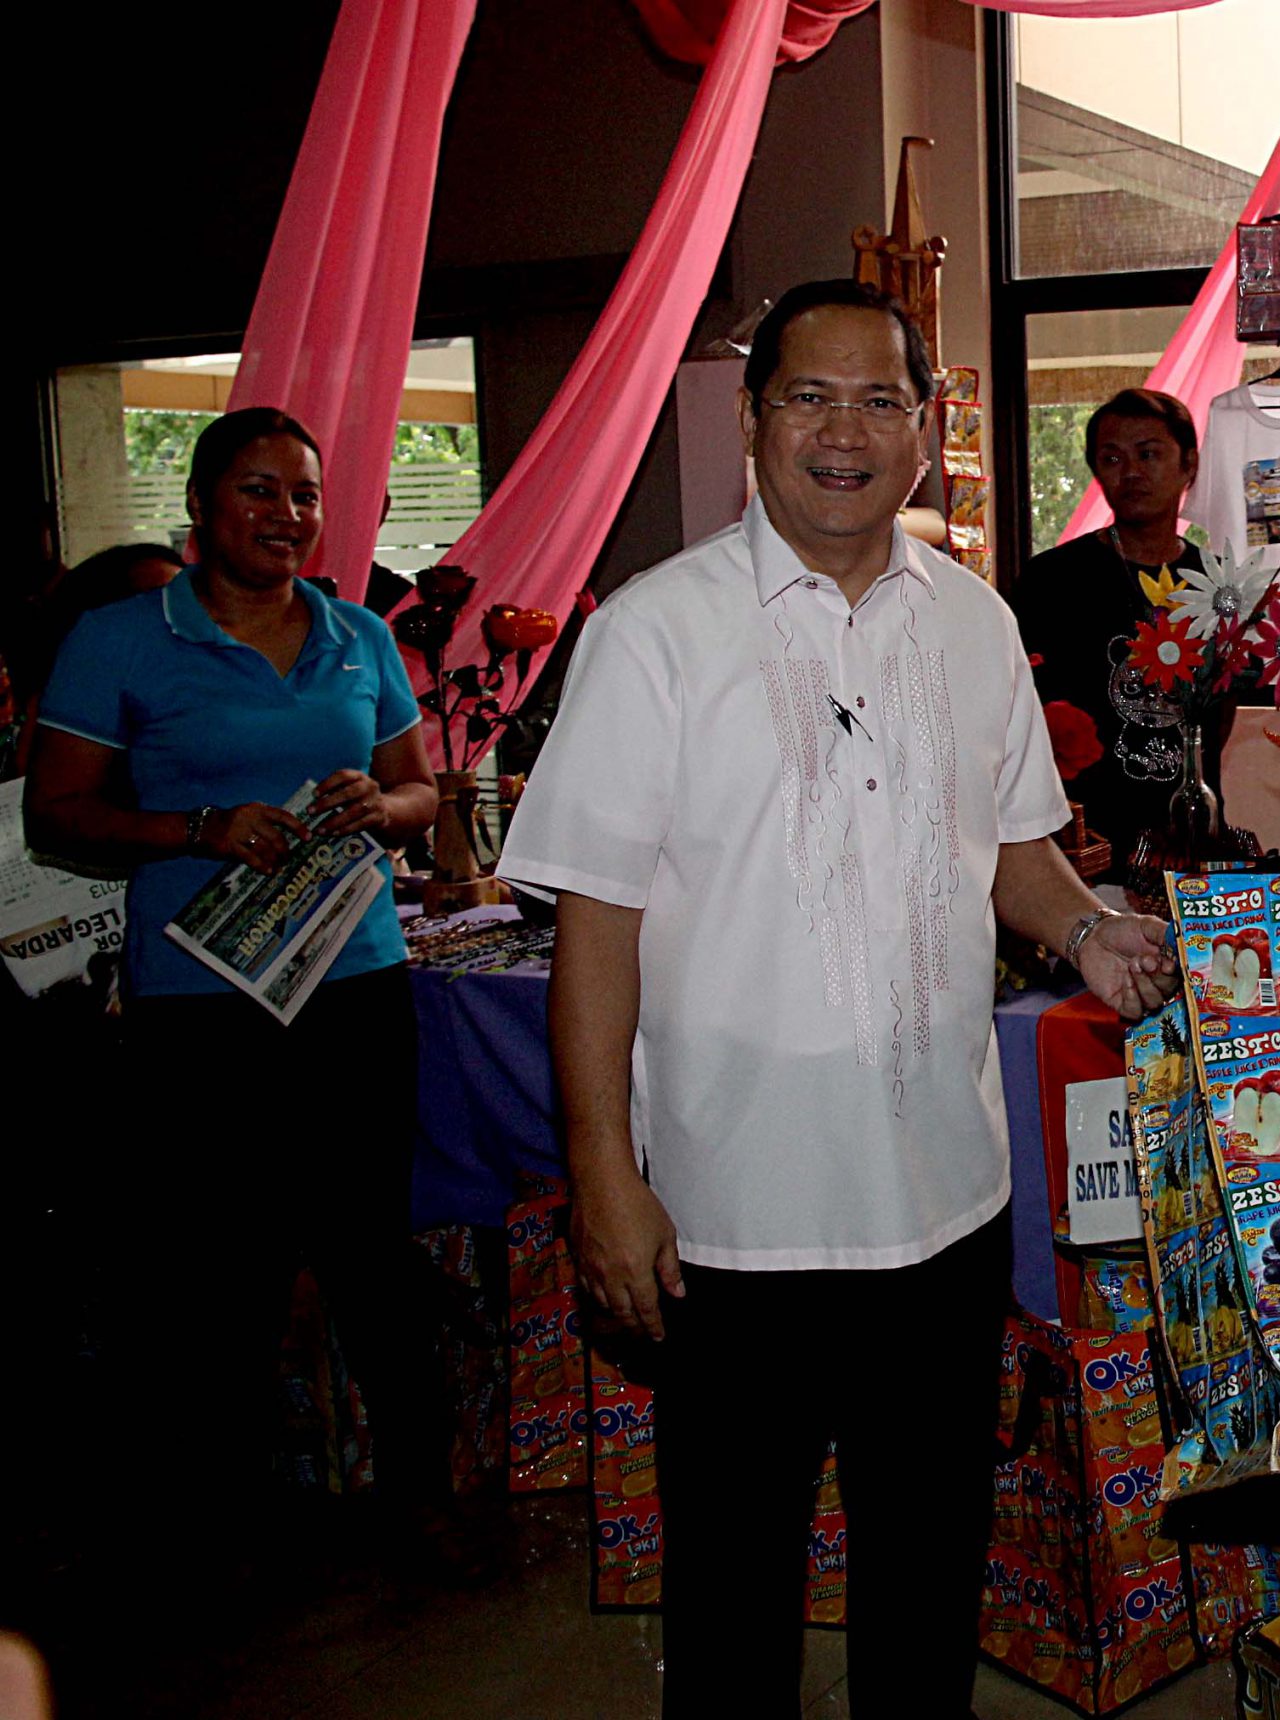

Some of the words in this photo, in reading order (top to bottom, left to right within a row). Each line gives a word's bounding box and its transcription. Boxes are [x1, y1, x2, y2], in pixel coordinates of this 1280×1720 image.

[11, 908, 121, 960] LEGARDA
[1185, 921, 1211, 932] APPLE
[1206, 1067, 1232, 1079] APPLE
[1076, 1161, 1120, 1202] SAVE
[1084, 1349, 1151, 1391] OK!
